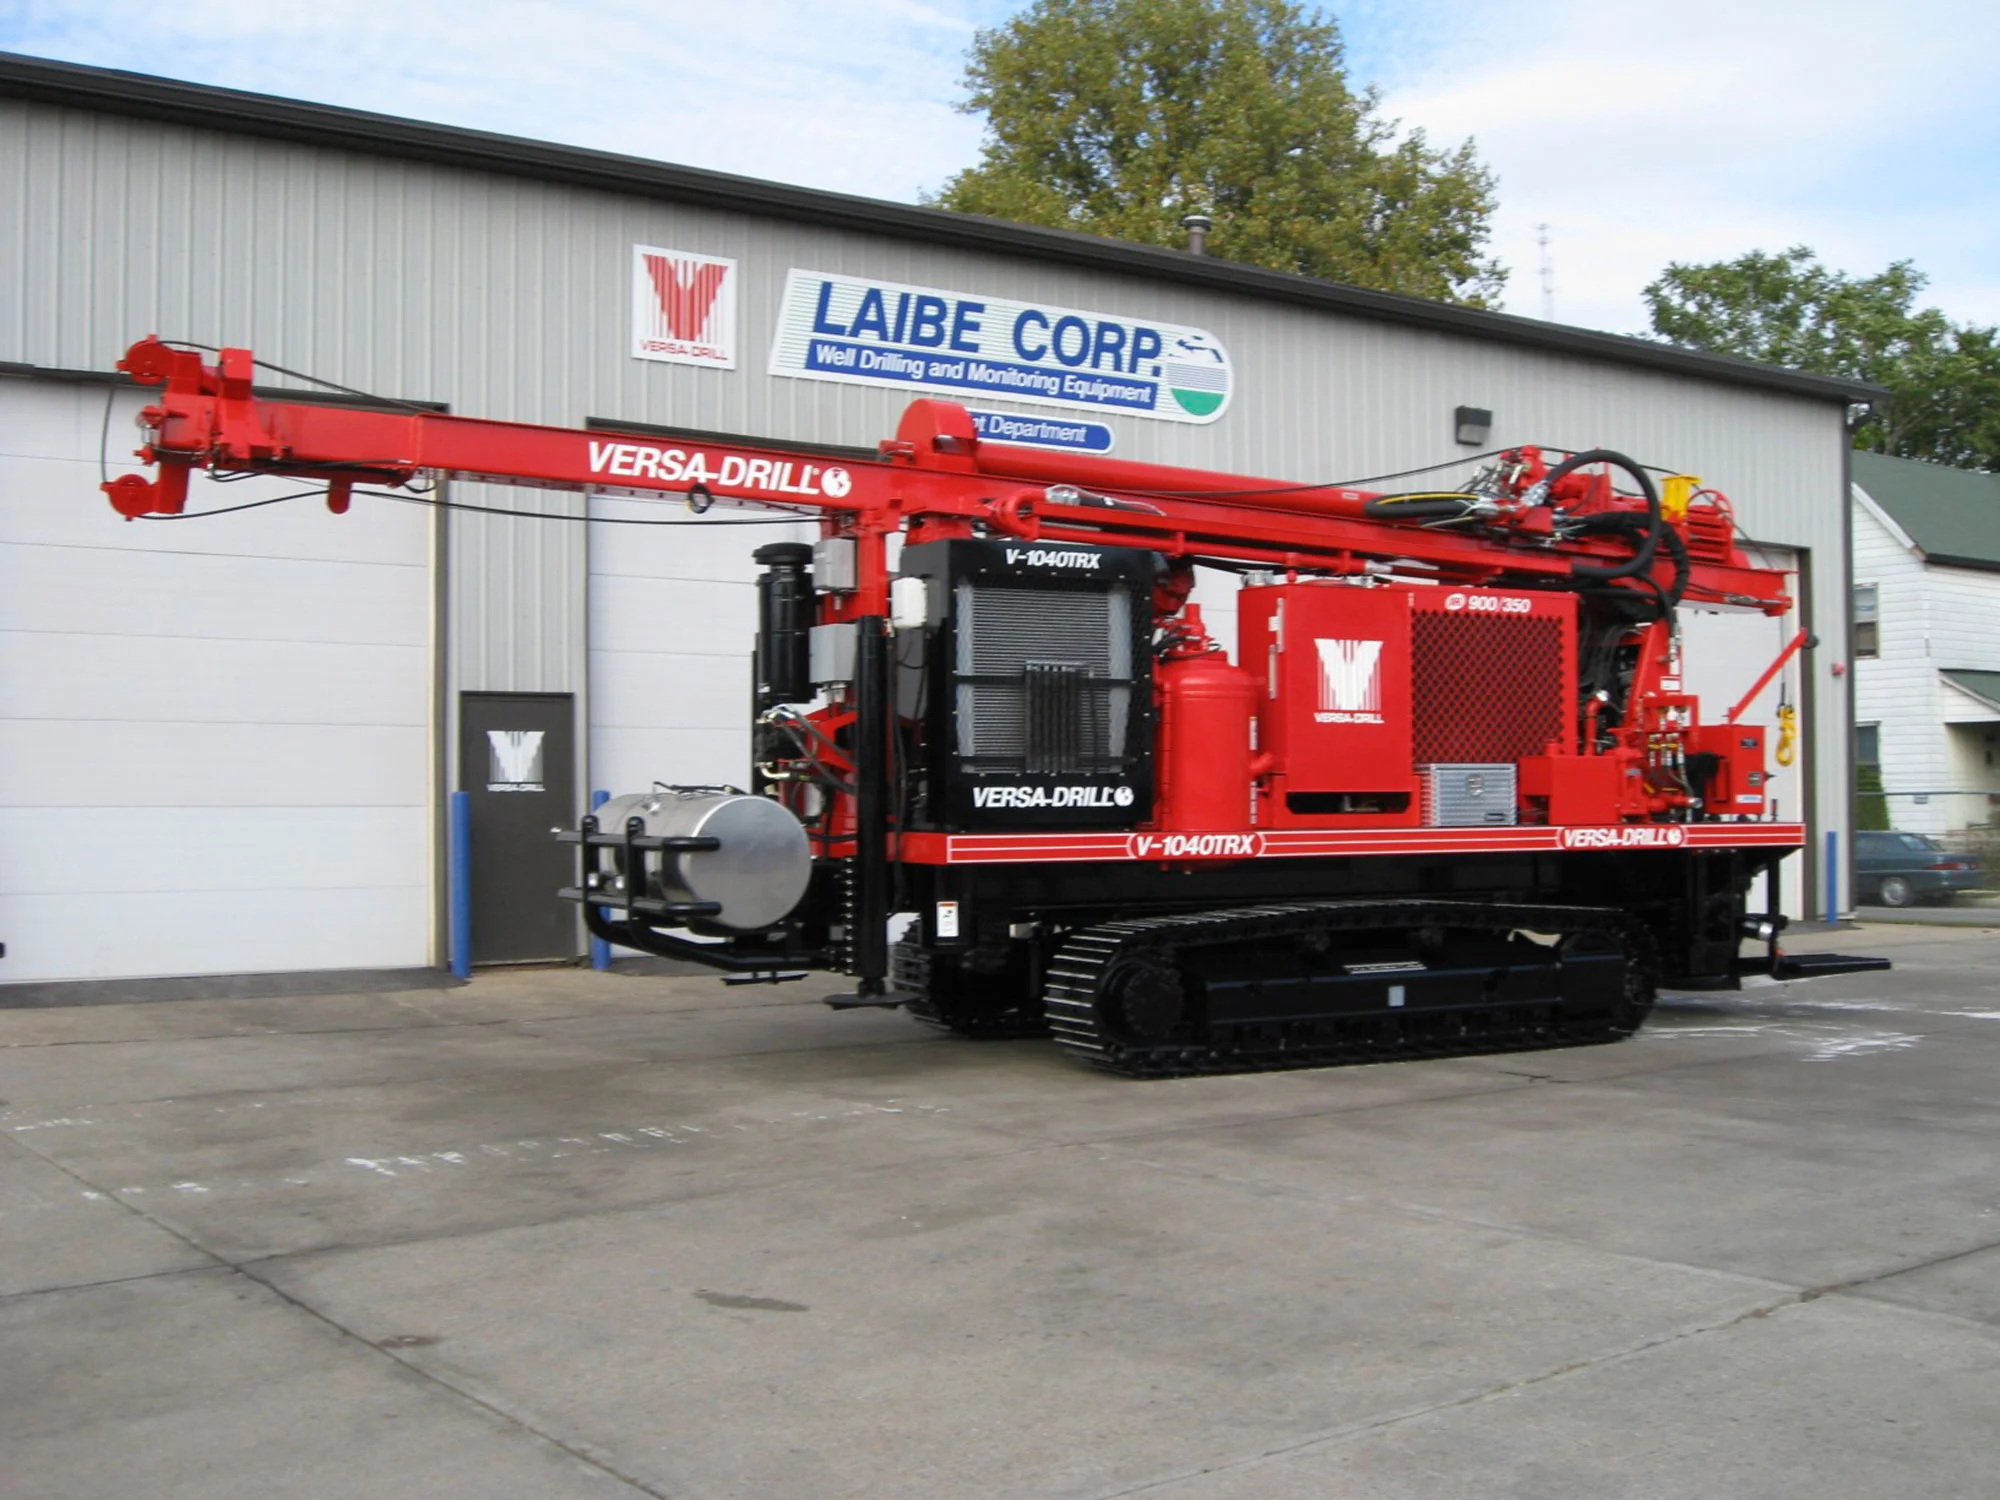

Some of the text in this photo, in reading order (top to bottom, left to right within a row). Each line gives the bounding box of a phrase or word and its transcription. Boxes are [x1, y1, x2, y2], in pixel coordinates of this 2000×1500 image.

[813, 281, 1162, 377] LAIBE CORP.
[816, 344, 1152, 404] Well Drilling and Monitoring Equipment
[989, 415, 1088, 443] Department
[588, 441, 820, 495] VERSA-DRILL
[1005, 548, 1102, 569] V-1040TRX
[972, 786, 1115, 808] VERSA-DRILL
[1136, 834, 1256, 857] V-1040TRX
[1564, 828, 1669, 848] VERSA-DRILL
